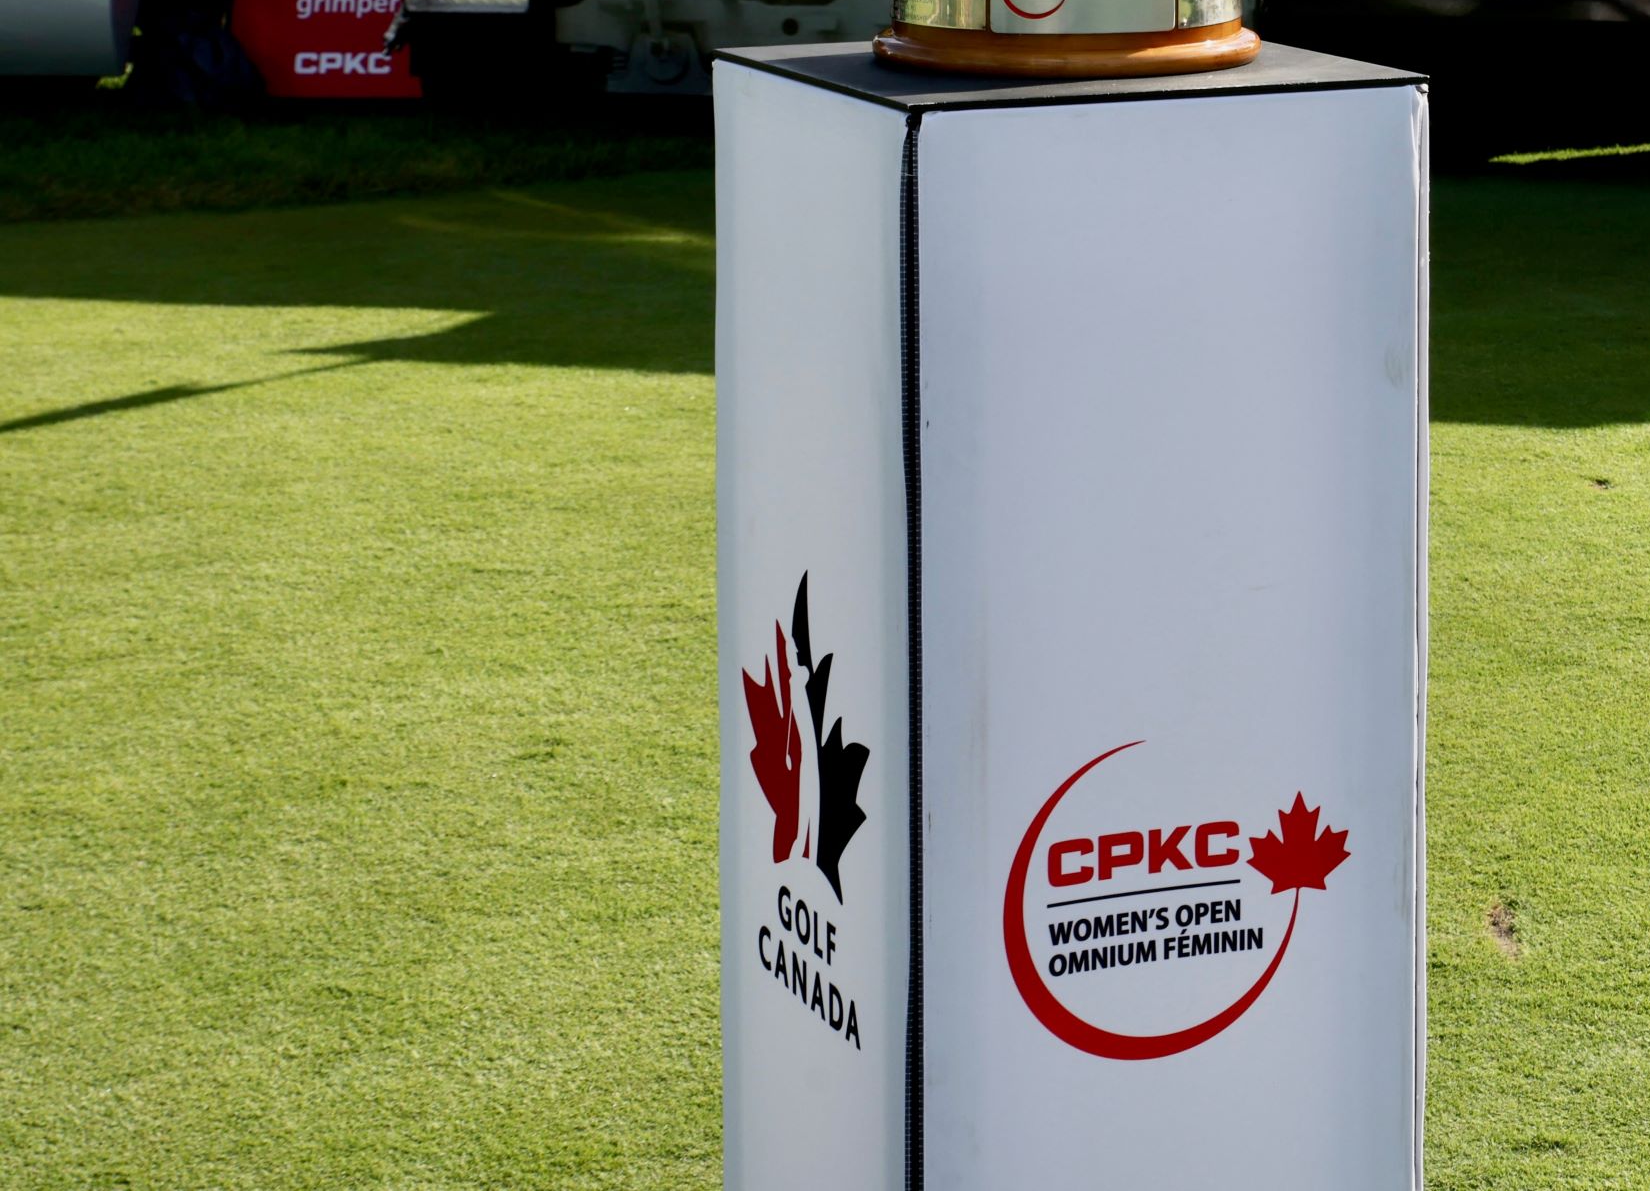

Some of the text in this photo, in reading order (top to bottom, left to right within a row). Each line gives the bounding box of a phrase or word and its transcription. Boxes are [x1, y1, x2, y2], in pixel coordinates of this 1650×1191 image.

[294, 51, 392, 75] CPKC
[1047, 820, 1240, 888] CPKC
[777, 885, 837, 966] GOLF
[1048, 899, 1242, 946] WOMEN'S OPEN
[1048, 927, 1264, 977] OMNIUM FÉMININ
[758, 925, 861, 1051] CANADA
